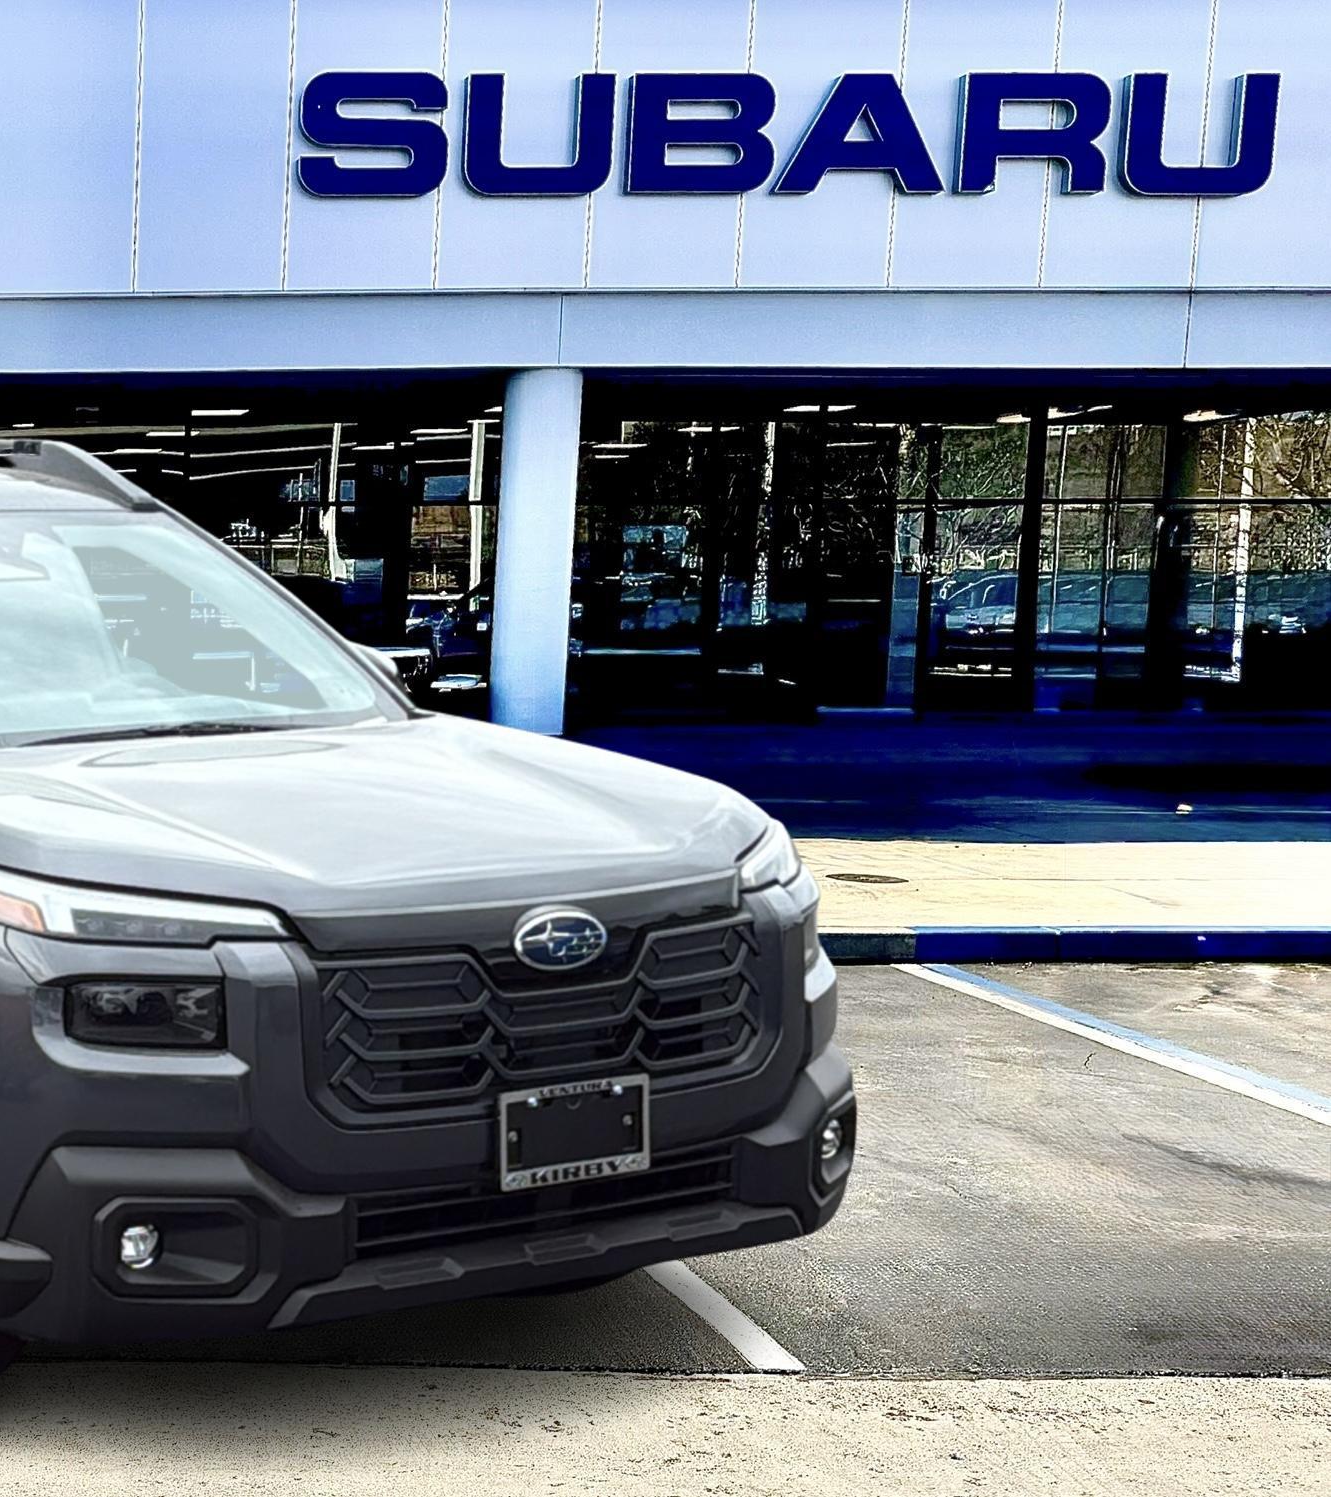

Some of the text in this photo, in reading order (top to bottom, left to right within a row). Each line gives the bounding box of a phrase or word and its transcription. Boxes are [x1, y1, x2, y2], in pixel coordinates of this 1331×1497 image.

[298, 71, 1281, 198] SUBARU
[539, 1081, 614, 1097] VENTURA
[530, 1159, 621, 1185] KIRBY
